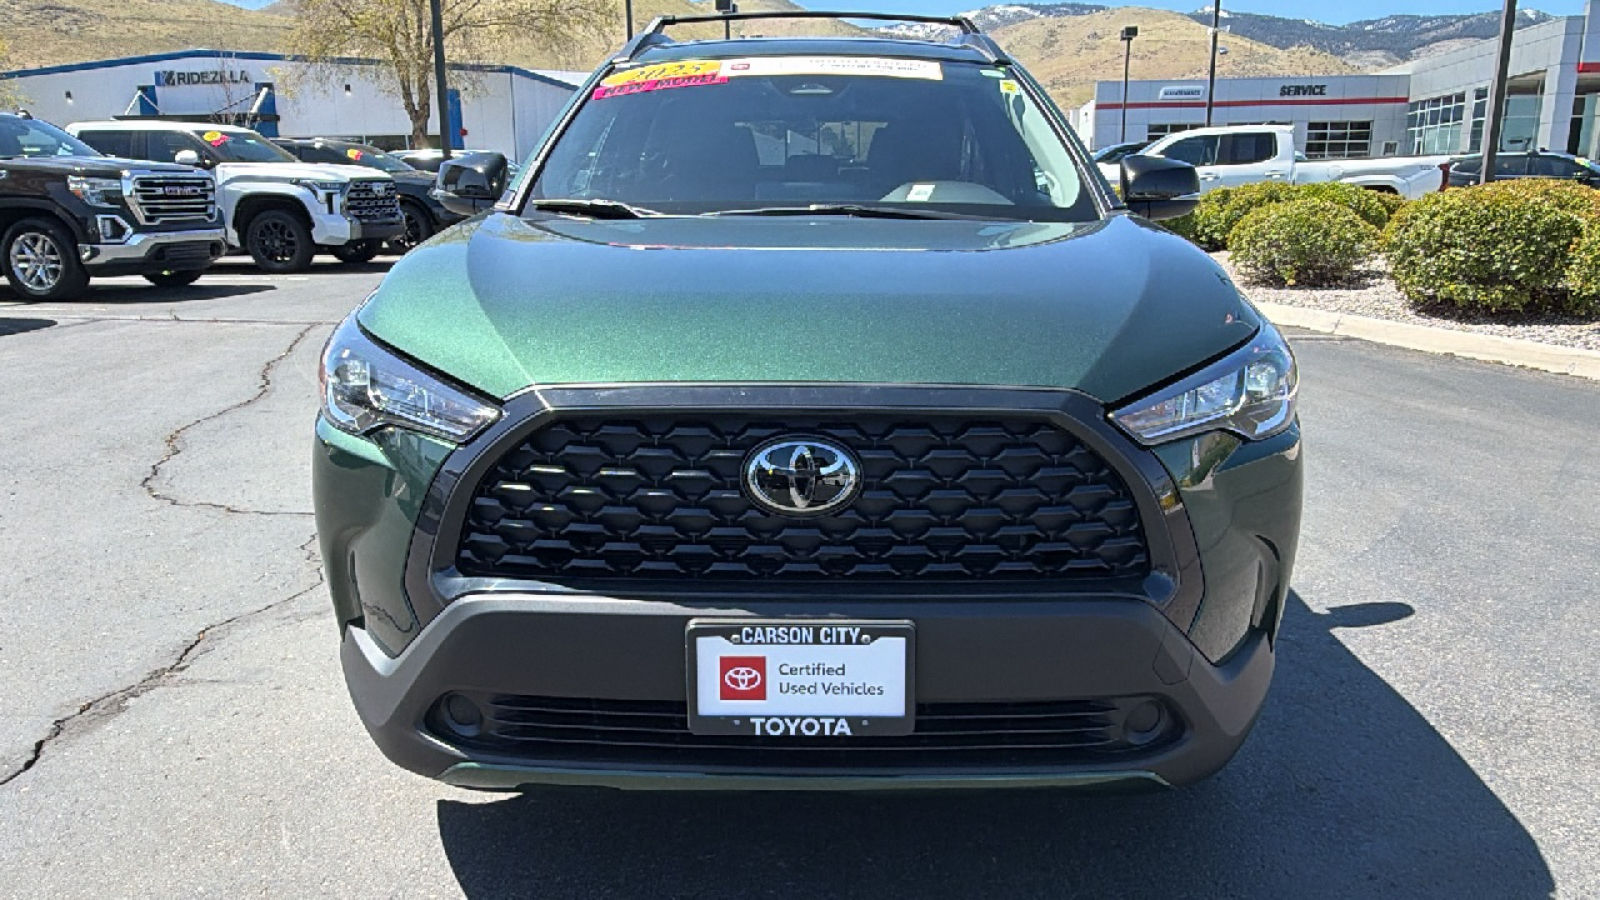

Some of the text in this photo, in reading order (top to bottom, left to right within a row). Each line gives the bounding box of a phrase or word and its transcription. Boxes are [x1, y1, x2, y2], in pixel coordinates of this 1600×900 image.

[1279, 84, 1328, 97] SERVICE
[741, 627, 861, 644] CARSON CITY
[778, 662, 846, 676] Certified
[779, 681, 885, 696] Used Vehicles
[750, 717, 852, 736] TOYOTA
